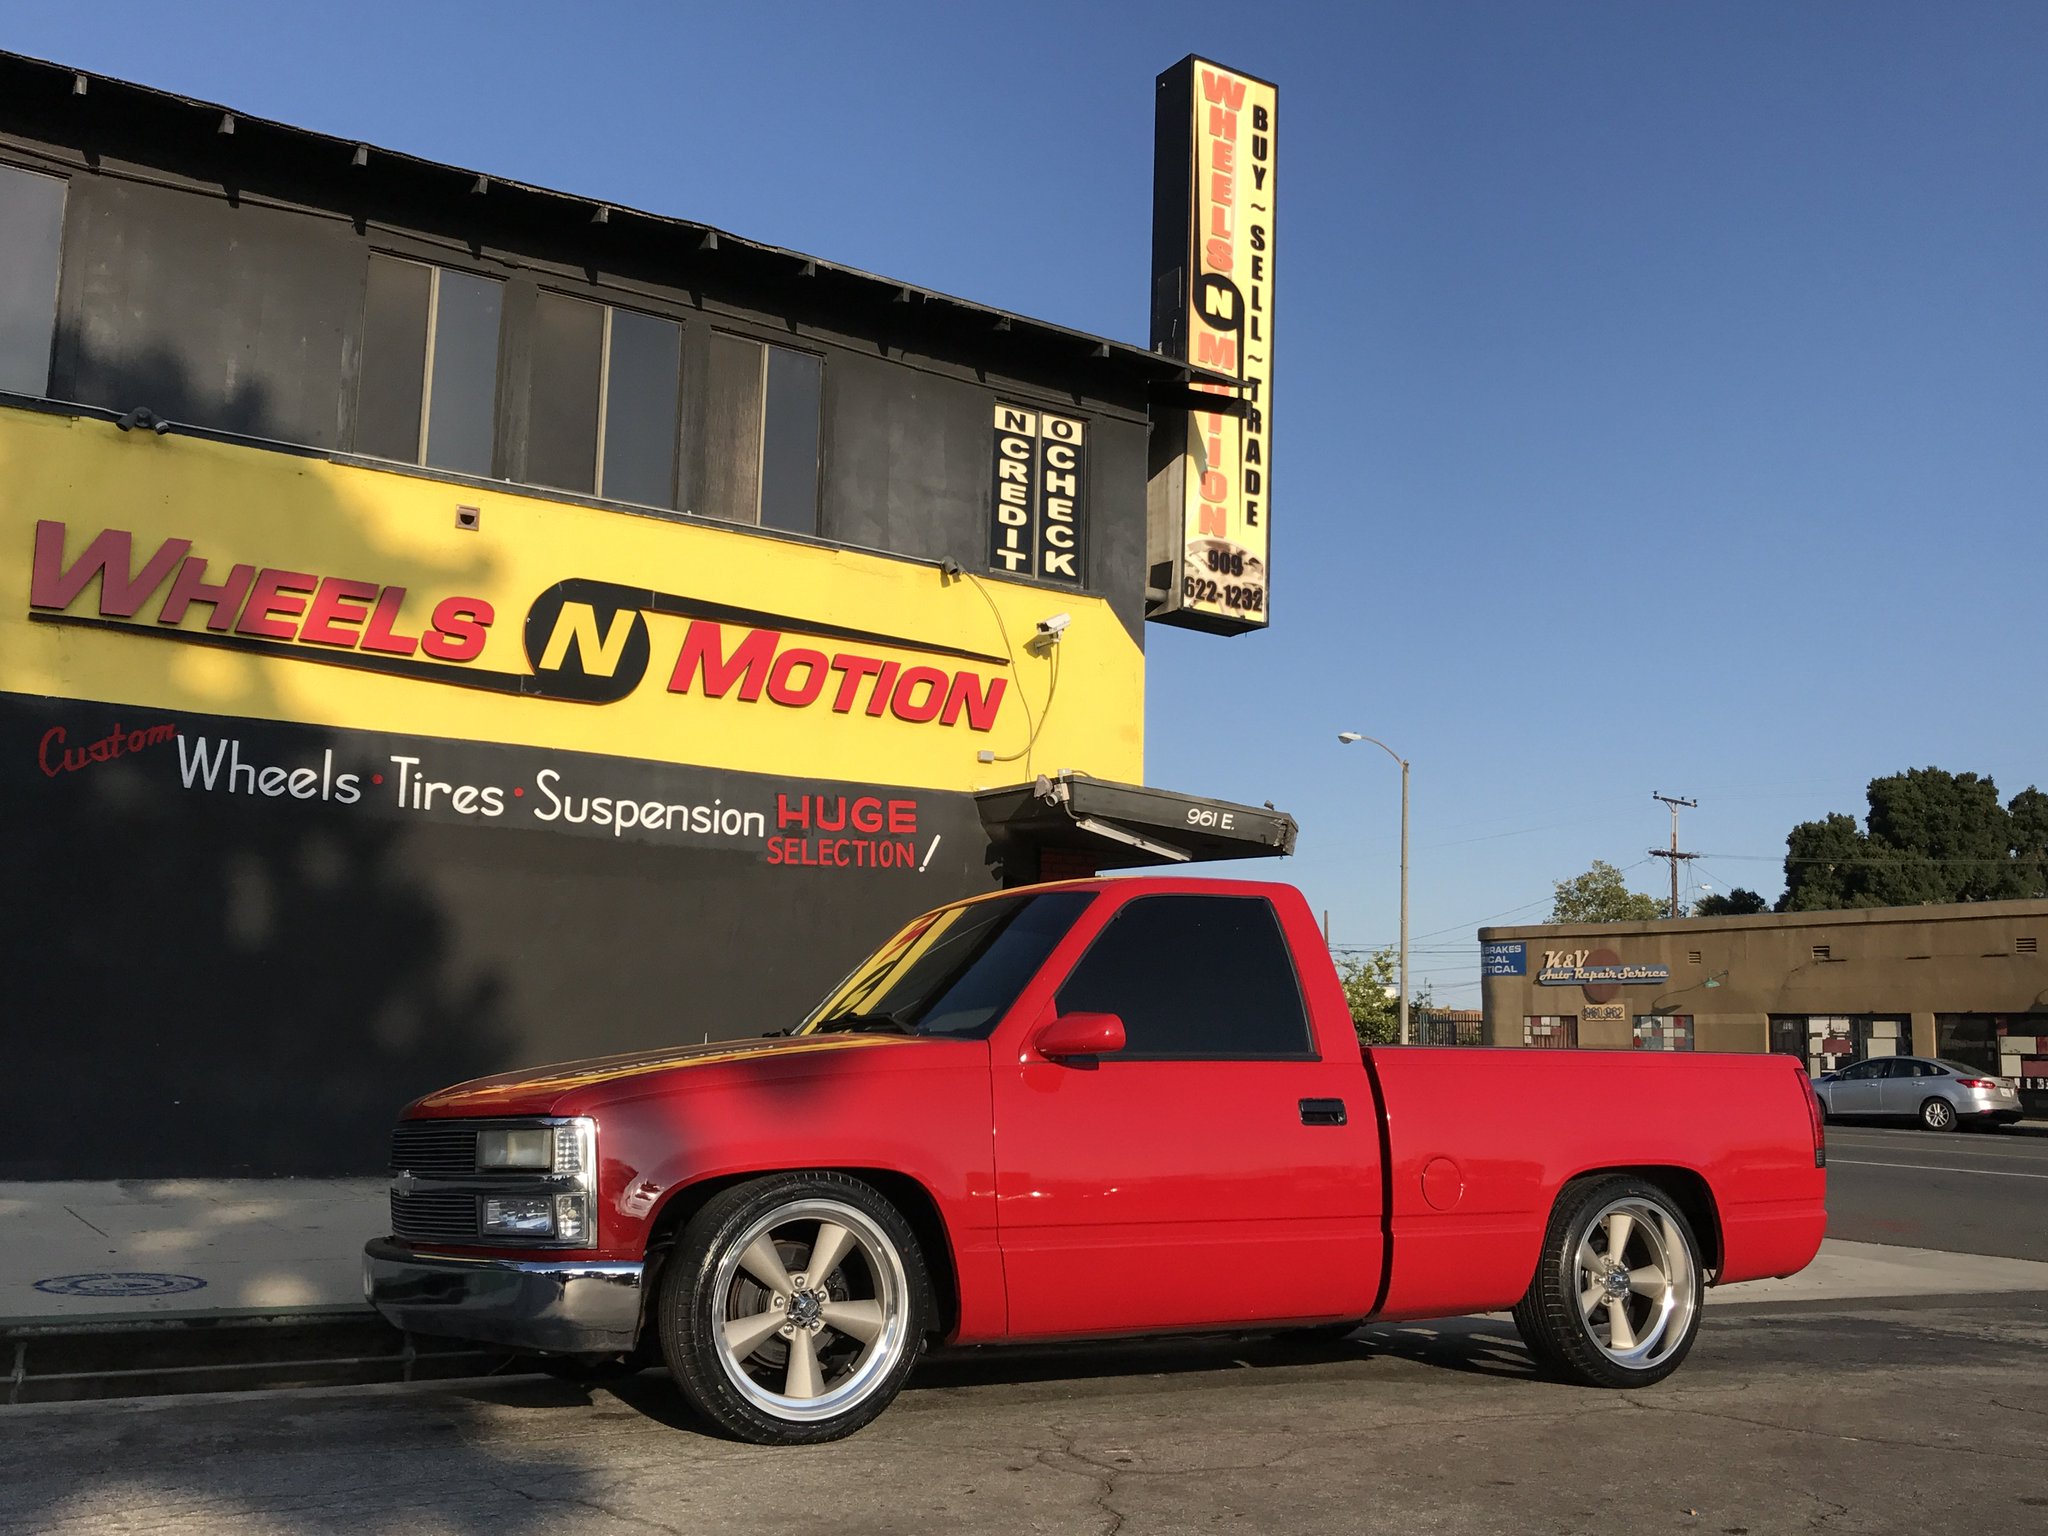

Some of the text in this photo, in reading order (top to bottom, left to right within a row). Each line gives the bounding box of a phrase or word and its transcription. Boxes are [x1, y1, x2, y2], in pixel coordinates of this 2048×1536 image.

[1202, 69, 1246, 272] WHEELS
[1205, 284, 1233, 320] N
[1245, 104, 1269, 527] BUY SELL TRADE
[997, 437, 1030, 571] CREDIT
[1046, 445, 1076, 577] CHECK
[30, 519, 1008, 731] WHEELS N MOTION
[1184, 576, 1263, 612] 622-1232
[38, 723, 764, 836] Custom Wheels Tires Suspension
[777, 793, 918, 834] HUGE
[1187, 809, 1217, 827] 961
[1539, 969, 1573, 981] Auto
[1574, 967, 1617, 982] Repair
[1544, 949, 1590, 968] K&V
